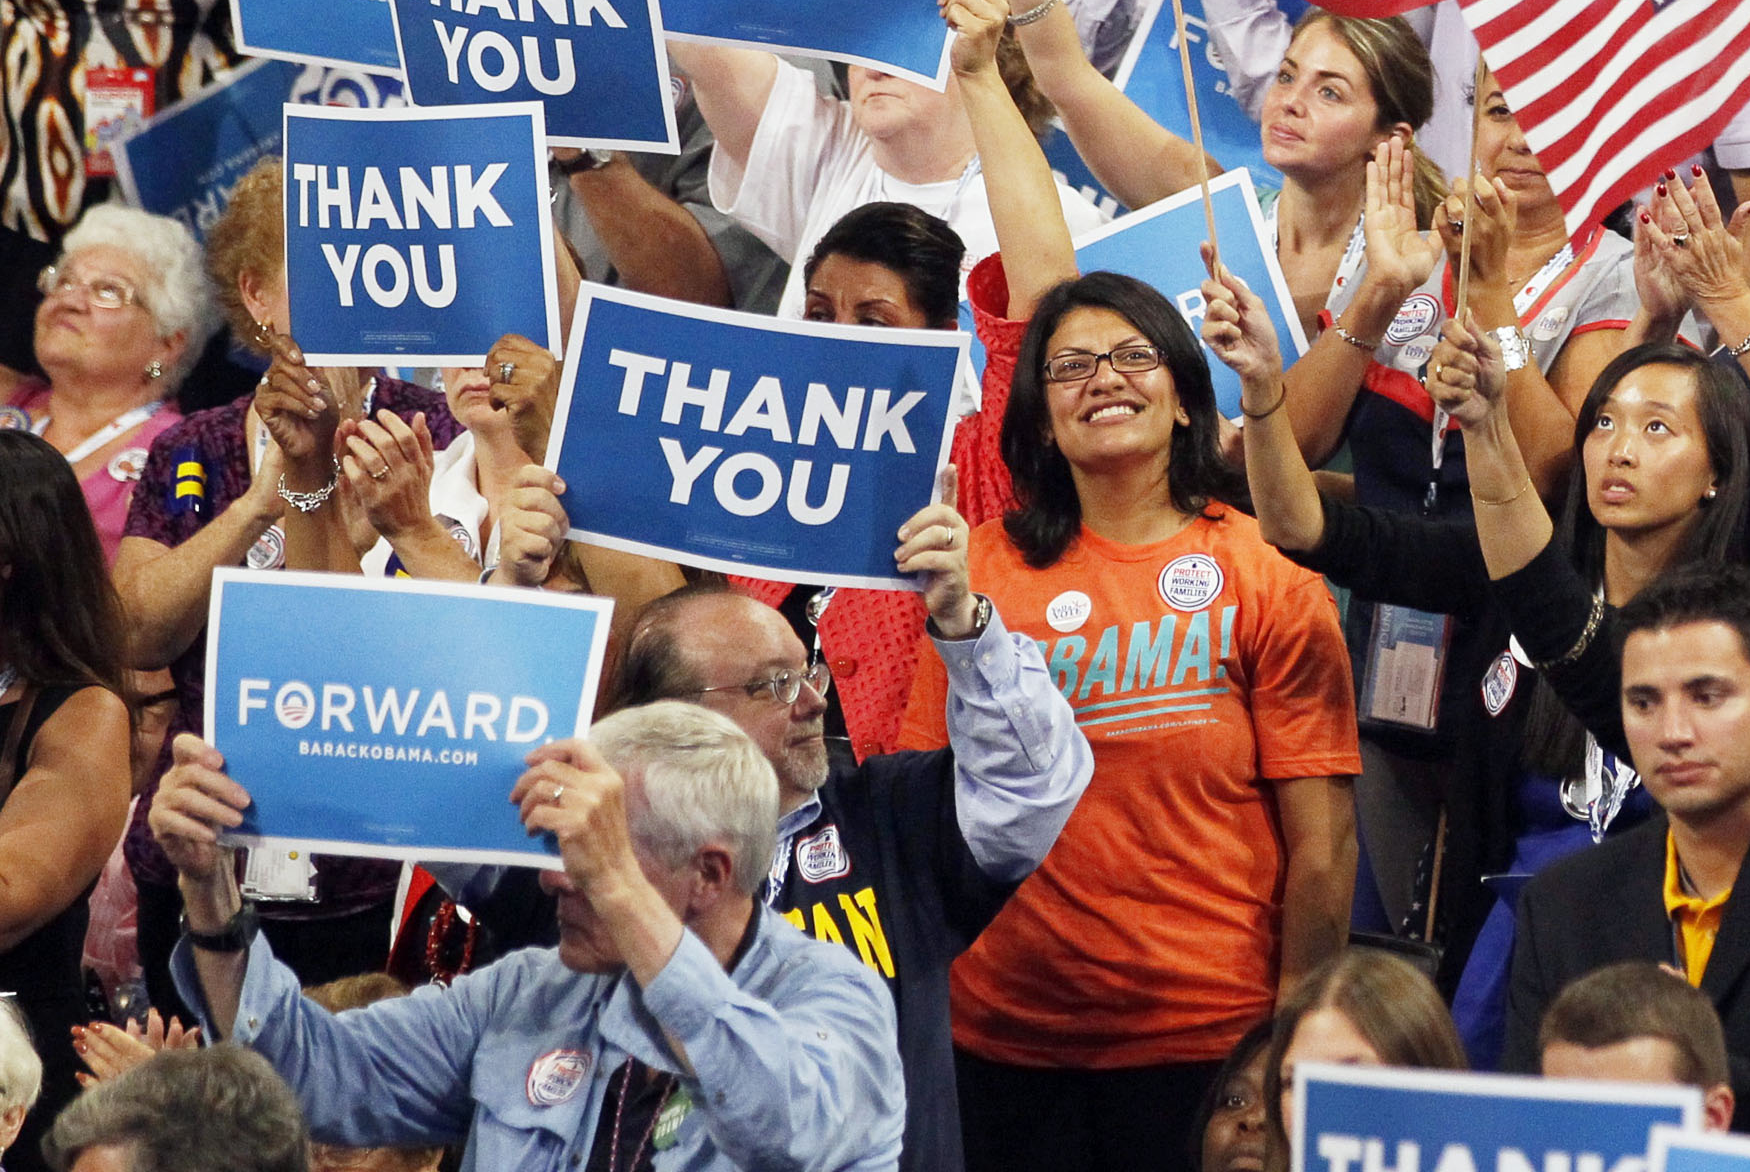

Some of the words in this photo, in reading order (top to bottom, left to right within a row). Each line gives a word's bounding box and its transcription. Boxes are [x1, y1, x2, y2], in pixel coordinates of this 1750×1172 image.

[433, 19, 577, 95] YOU
[294, 163, 514, 230] THANK
[321, 243, 457, 309] YOU
[609, 349, 927, 454] THANK
[658, 437, 851, 526] YOU
[1169, 587, 1208, 598] FAMILIES
[1171, 577, 1210, 588] WORKING
[1173, 568, 1211, 578] PROTECT
[1040, 605, 1239, 702] BAMA!
[238, 678, 554, 745] FORWARD.
[299, 741, 479, 766] BARACKOBAMA.COM
